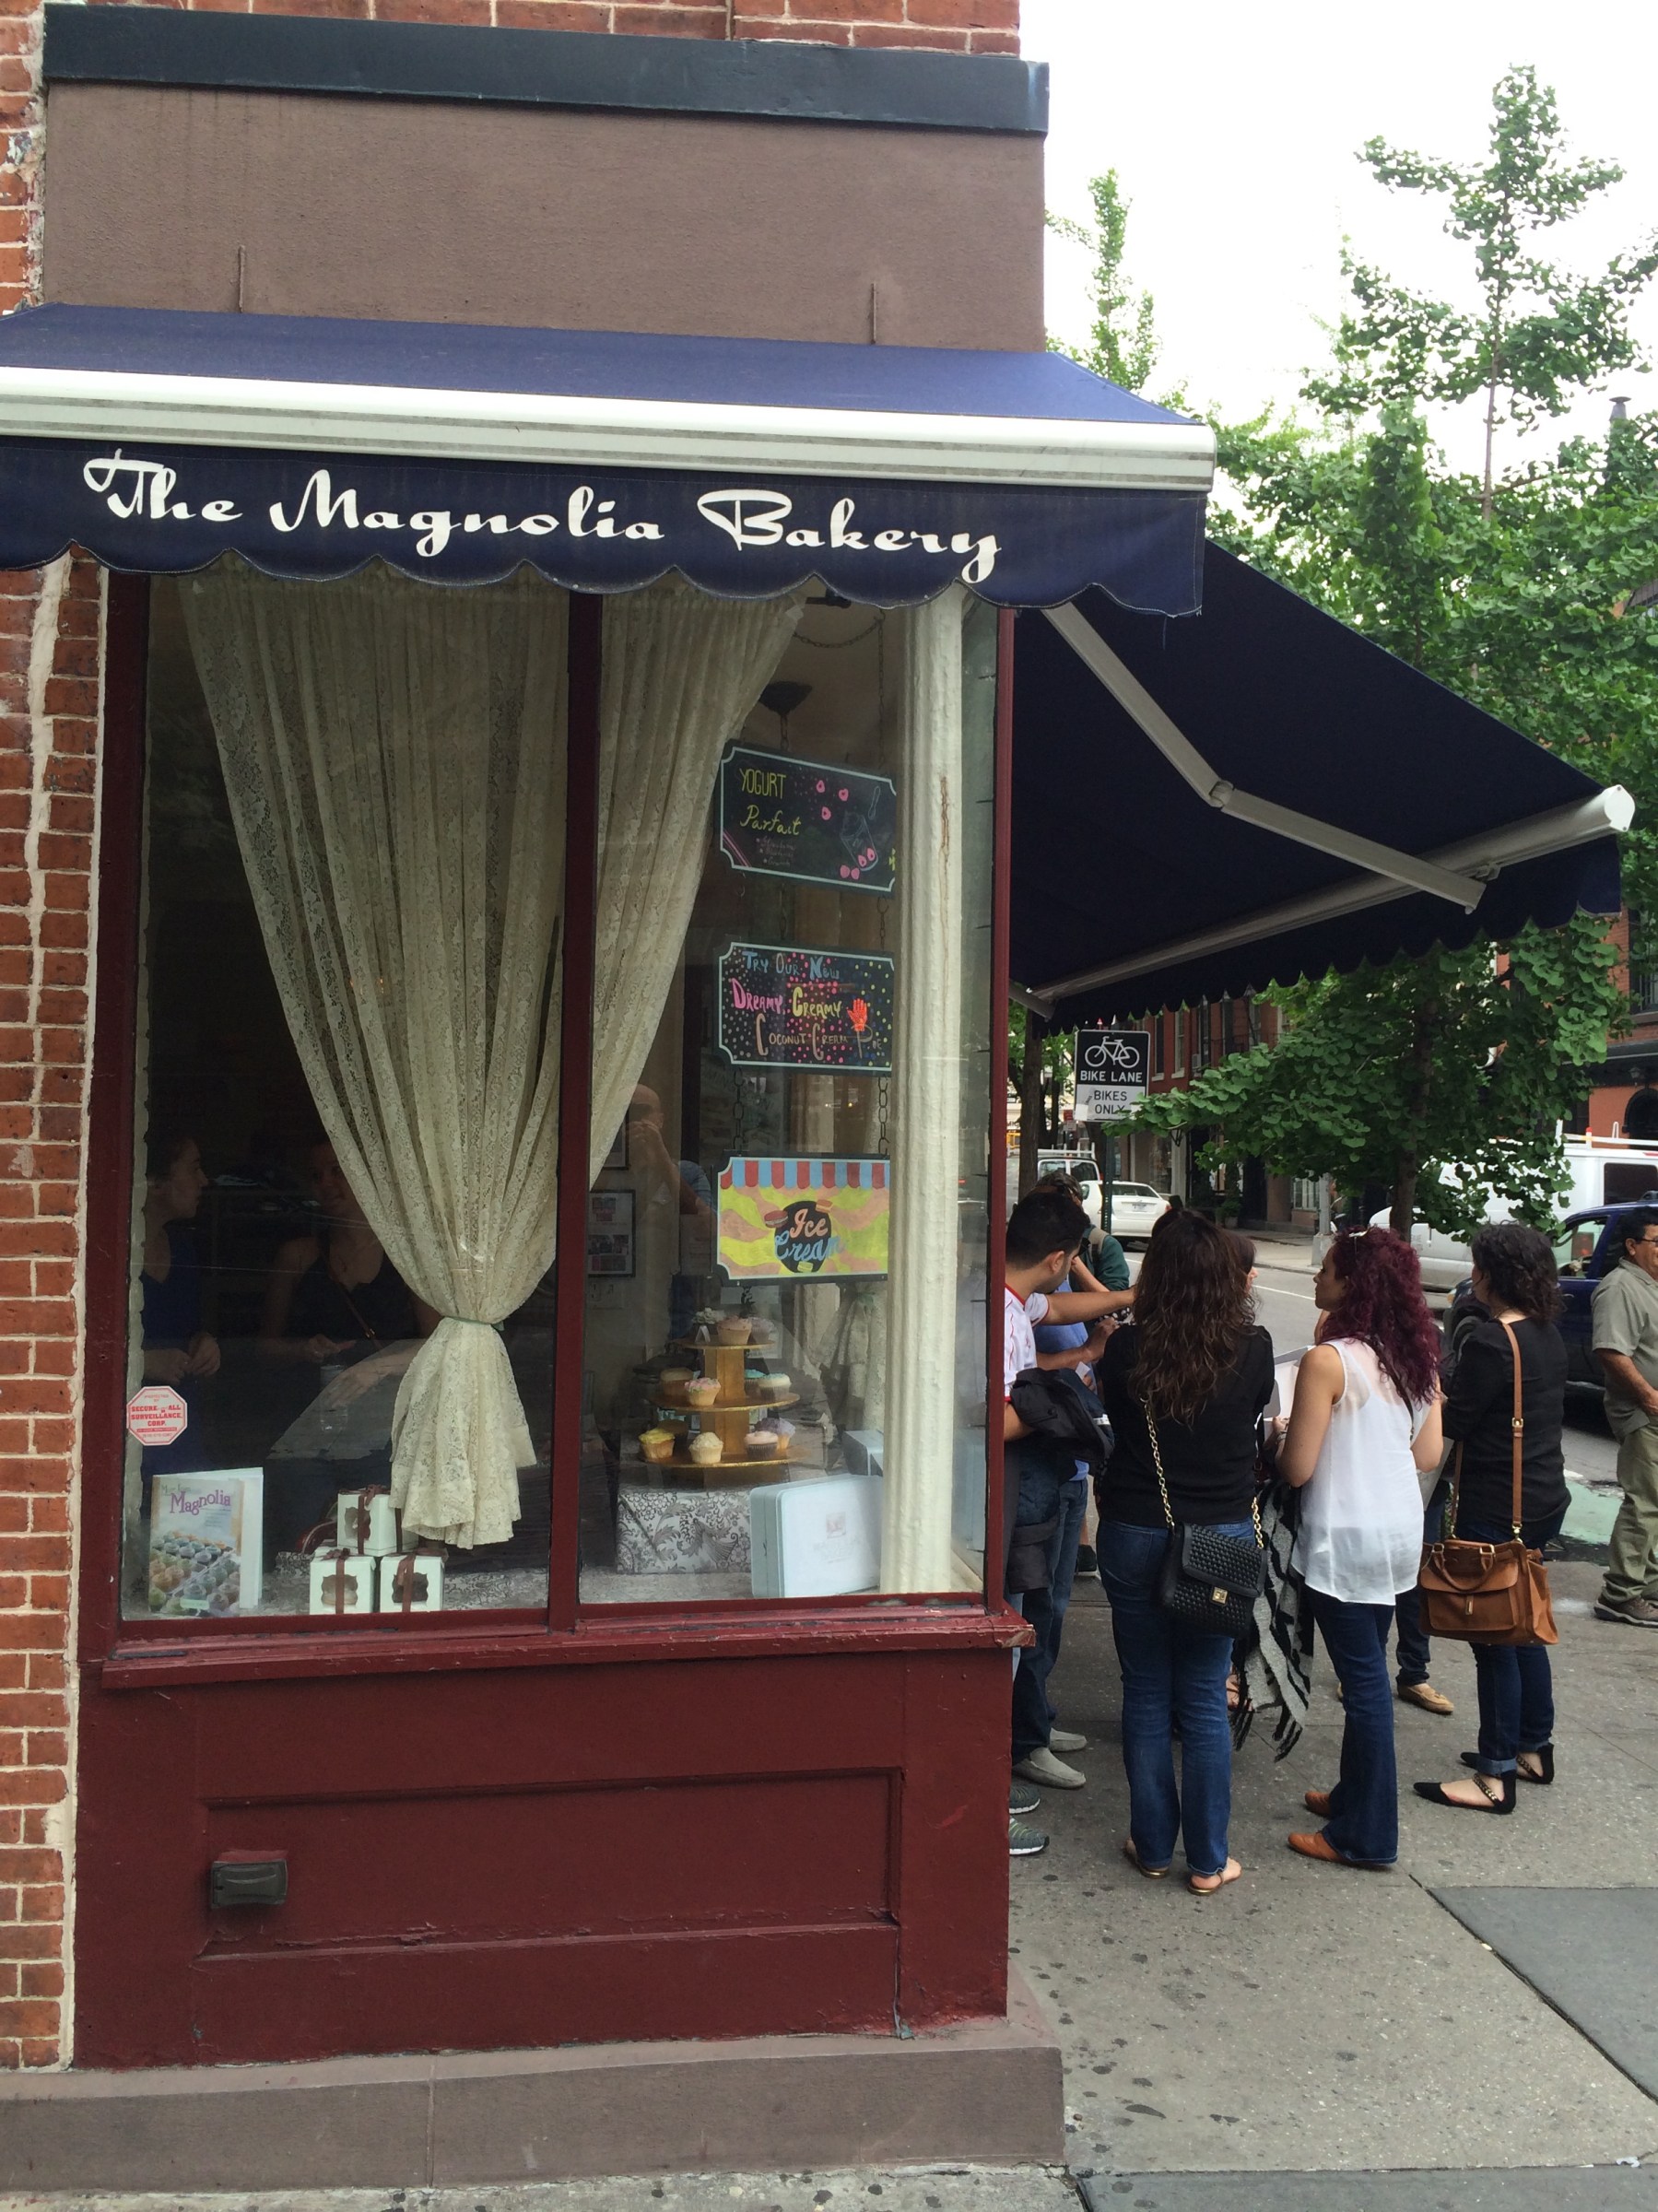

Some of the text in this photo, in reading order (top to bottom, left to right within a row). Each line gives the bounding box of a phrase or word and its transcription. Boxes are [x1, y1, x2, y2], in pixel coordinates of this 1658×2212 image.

[84, 449, 1002, 583] The Magnolia Bakery
[739, 768, 786, 799] YOGURT
[740, 805, 802, 835] Parfait
[757, 1013, 807, 1056] COCONUT
[1080, 1070, 1143, 1083] BIKE LANE
[1094, 1090, 1127, 1101] BIKES
[790, 1208, 828, 1238] Ice
[775, 1230, 841, 1262] Cream
[170, 1489, 231, 1516] Magnolia
